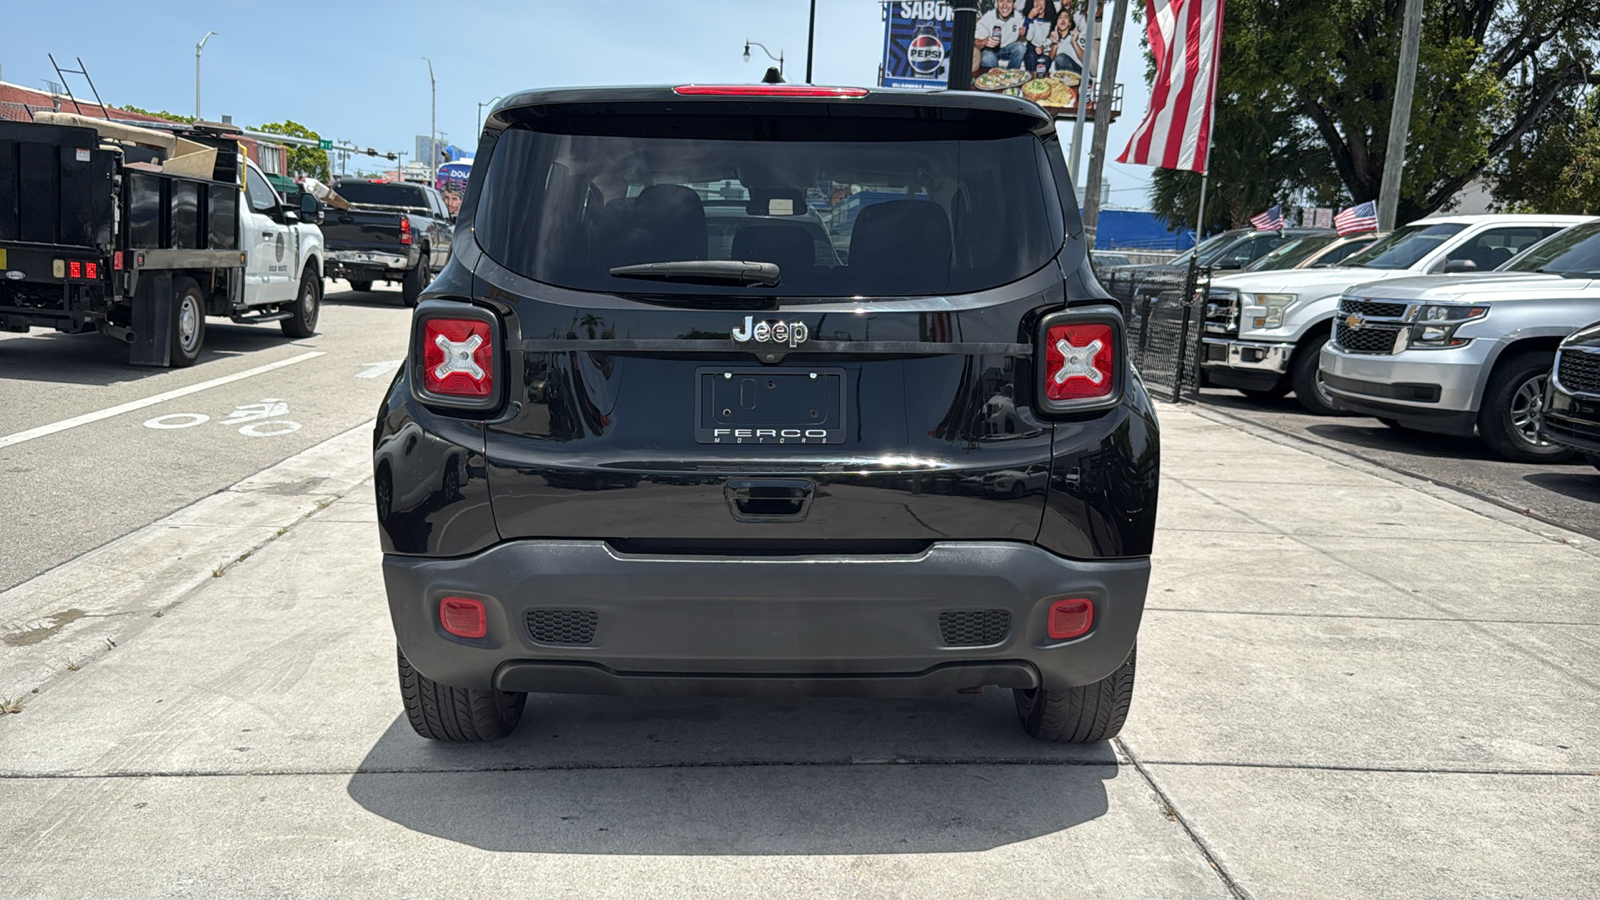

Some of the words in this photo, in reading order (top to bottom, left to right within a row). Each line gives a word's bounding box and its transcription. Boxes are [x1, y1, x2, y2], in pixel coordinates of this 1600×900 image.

[910, 49, 942, 59] PEPSI
[451, 170, 470, 178] DOL
[732, 315, 808, 347] Jeep
[714, 428, 827, 437] FERCO
